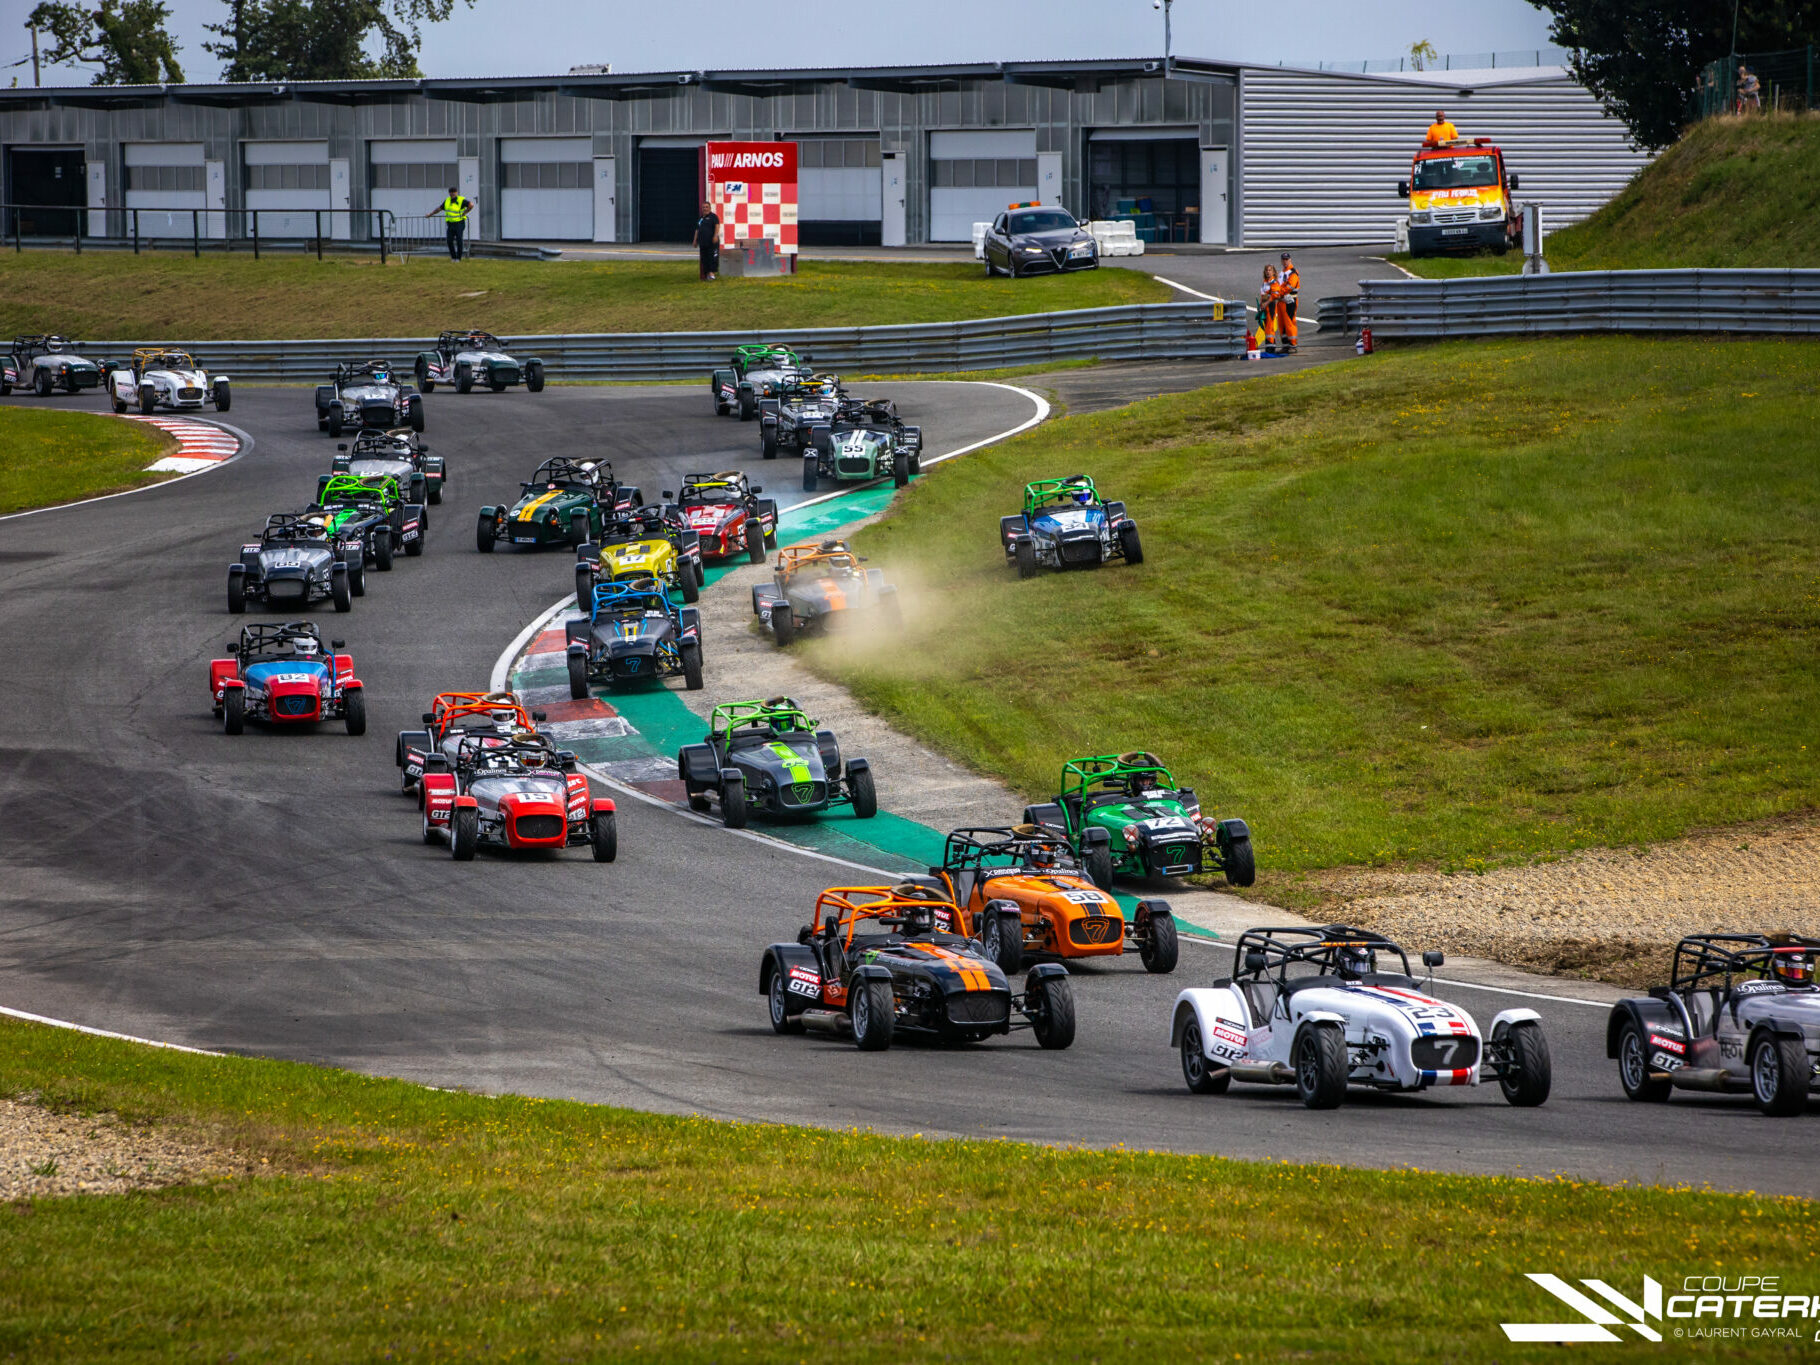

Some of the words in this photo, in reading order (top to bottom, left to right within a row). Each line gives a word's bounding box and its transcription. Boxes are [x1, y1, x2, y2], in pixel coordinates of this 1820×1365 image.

[733, 152, 784, 168] ARNOS
[626, 657, 641, 673] 7
[1166, 845, 1186, 865] 7
[1085, 920, 1107, 942] 7
[791, 970, 819, 984] MOTUL
[1406, 1006, 1455, 1020] 23
[1215, 1028, 1246, 1044] MOTUL
[1433, 1040, 1460, 1065] 7
[1652, 1036, 1684, 1053] MOTUL
